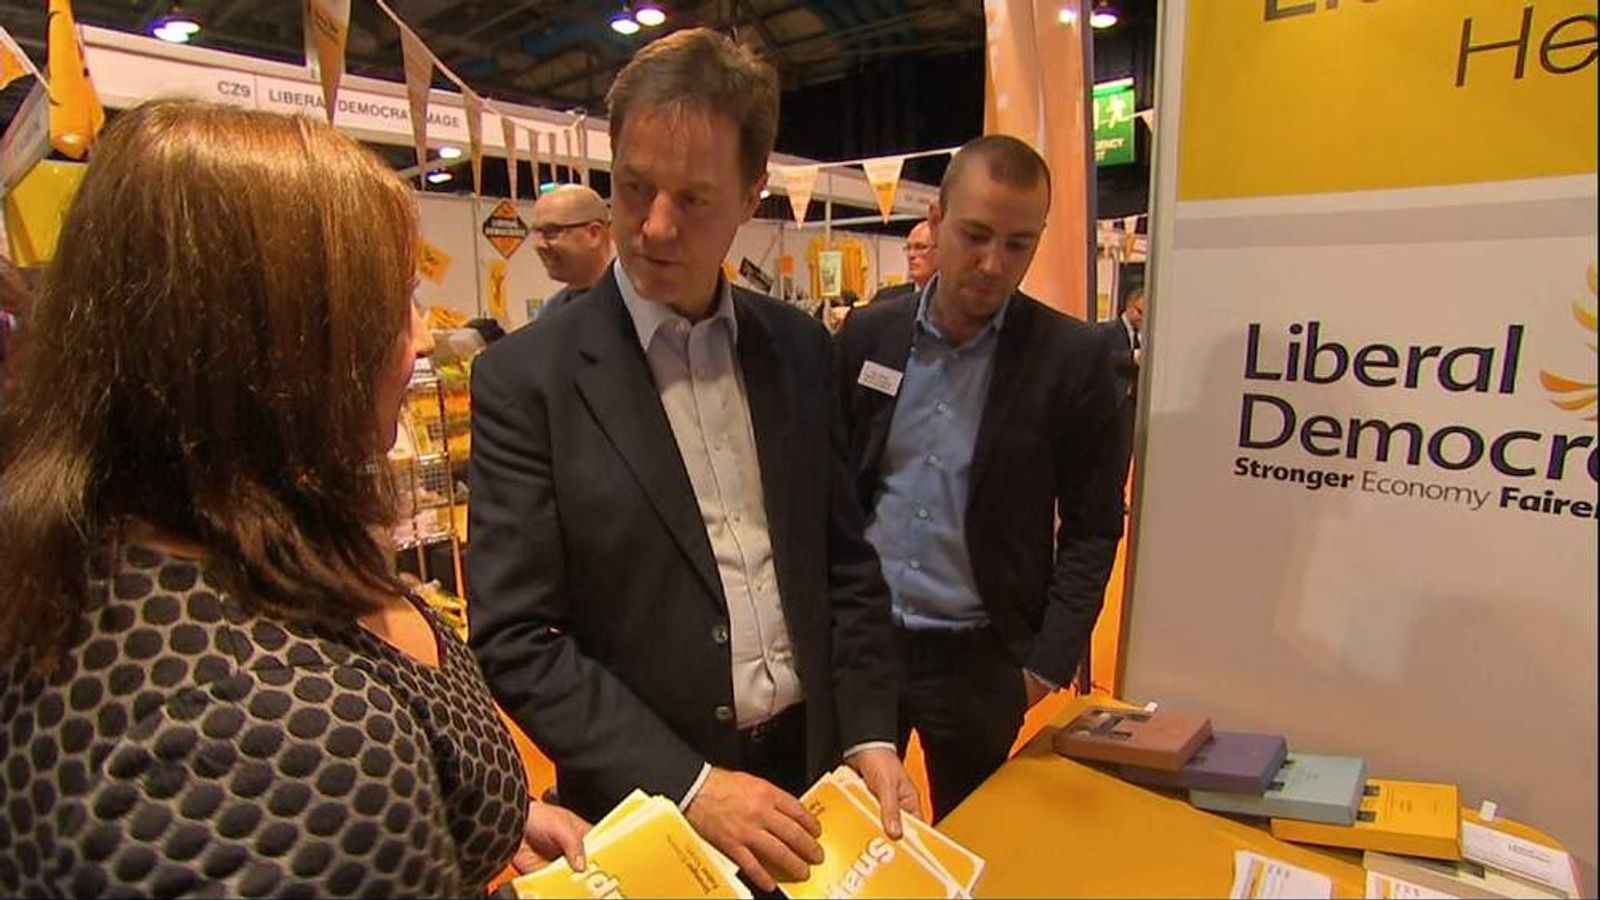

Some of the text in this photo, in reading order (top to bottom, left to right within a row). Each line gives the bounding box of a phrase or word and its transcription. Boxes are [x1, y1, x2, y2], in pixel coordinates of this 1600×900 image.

[217, 81, 460, 127] CZ9 LIBERA DEMOCRA MAGE
[1243, 321, 1524, 394] Liberal
[1238, 393, 1598, 482] Democr
[1233, 456, 1598, 519] Stronger Economy Faire
